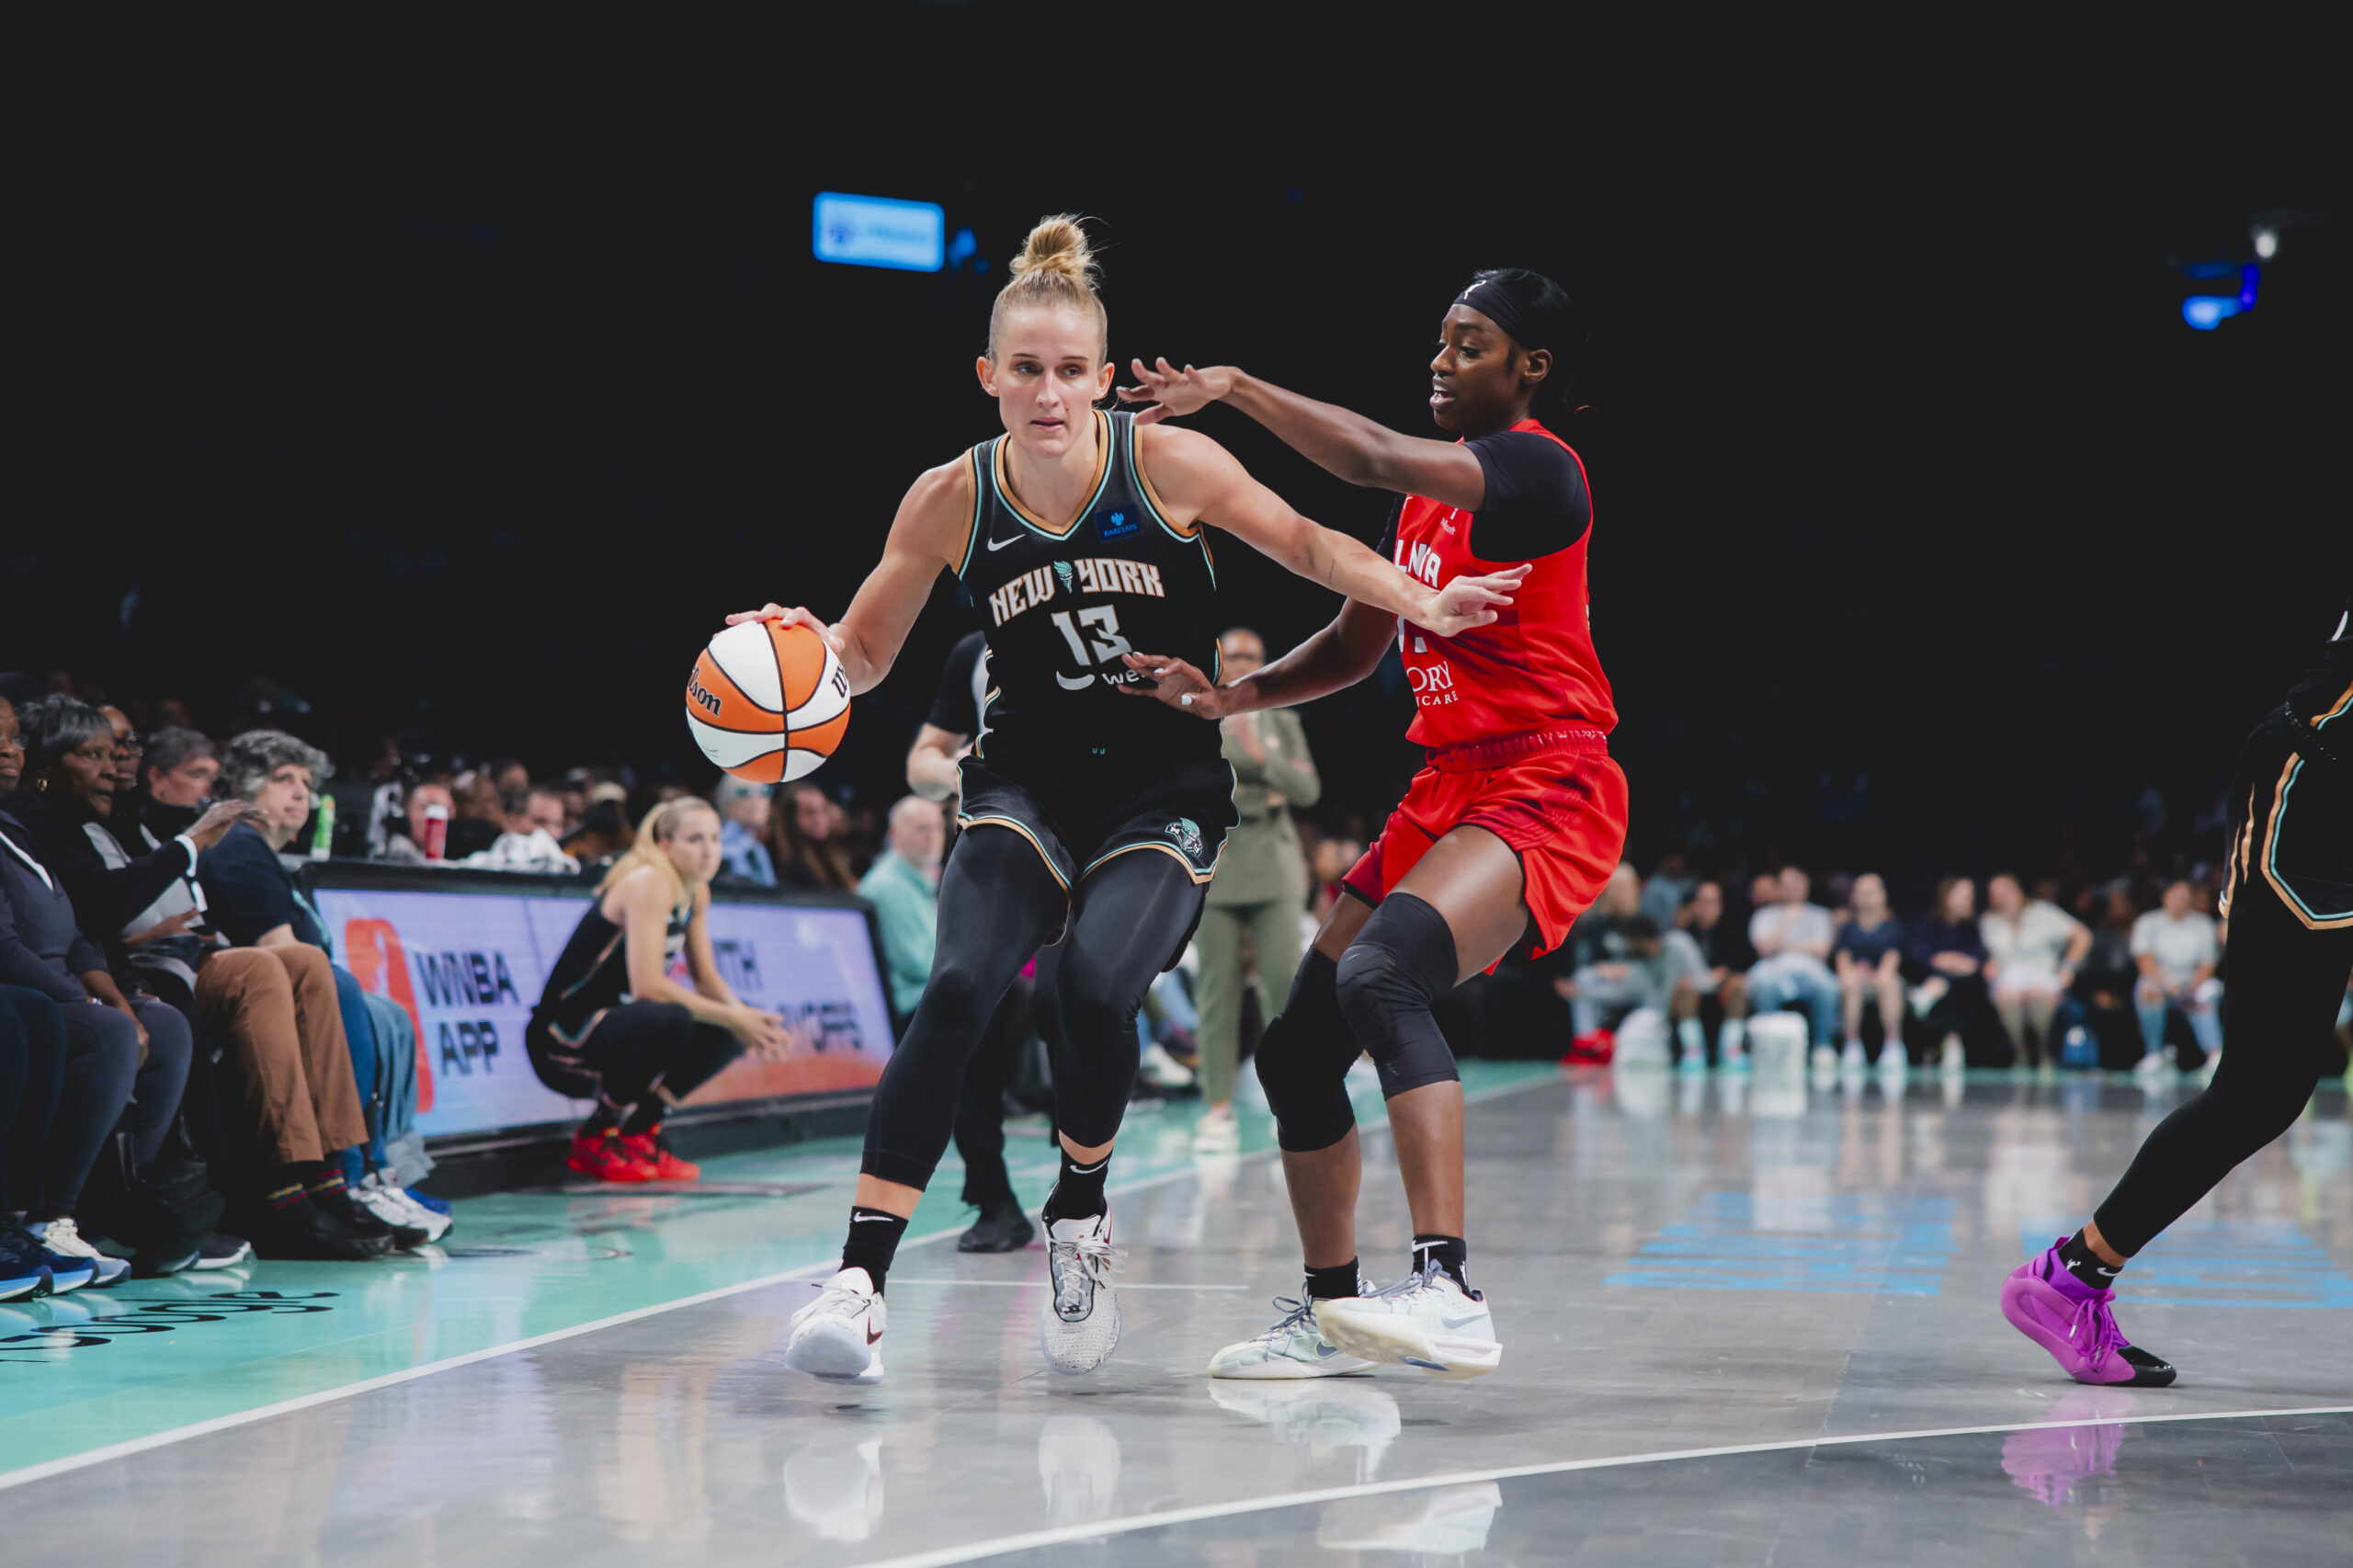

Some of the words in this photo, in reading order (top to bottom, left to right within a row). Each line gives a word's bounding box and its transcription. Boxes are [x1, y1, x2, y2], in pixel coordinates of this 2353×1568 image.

[1104, 523, 1138, 538] BARCLAYS
[988, 564, 1056, 628] NEW
[1074, 558, 1165, 598] YORK
[1051, 604, 1133, 666] 13
[688, 665, 722, 717] lson
[1101, 669, 1145, 686] we
[1406, 660, 1454, 693] ORY
[415, 950, 520, 1006] WNBA
[438, 1020, 499, 1076] APP
